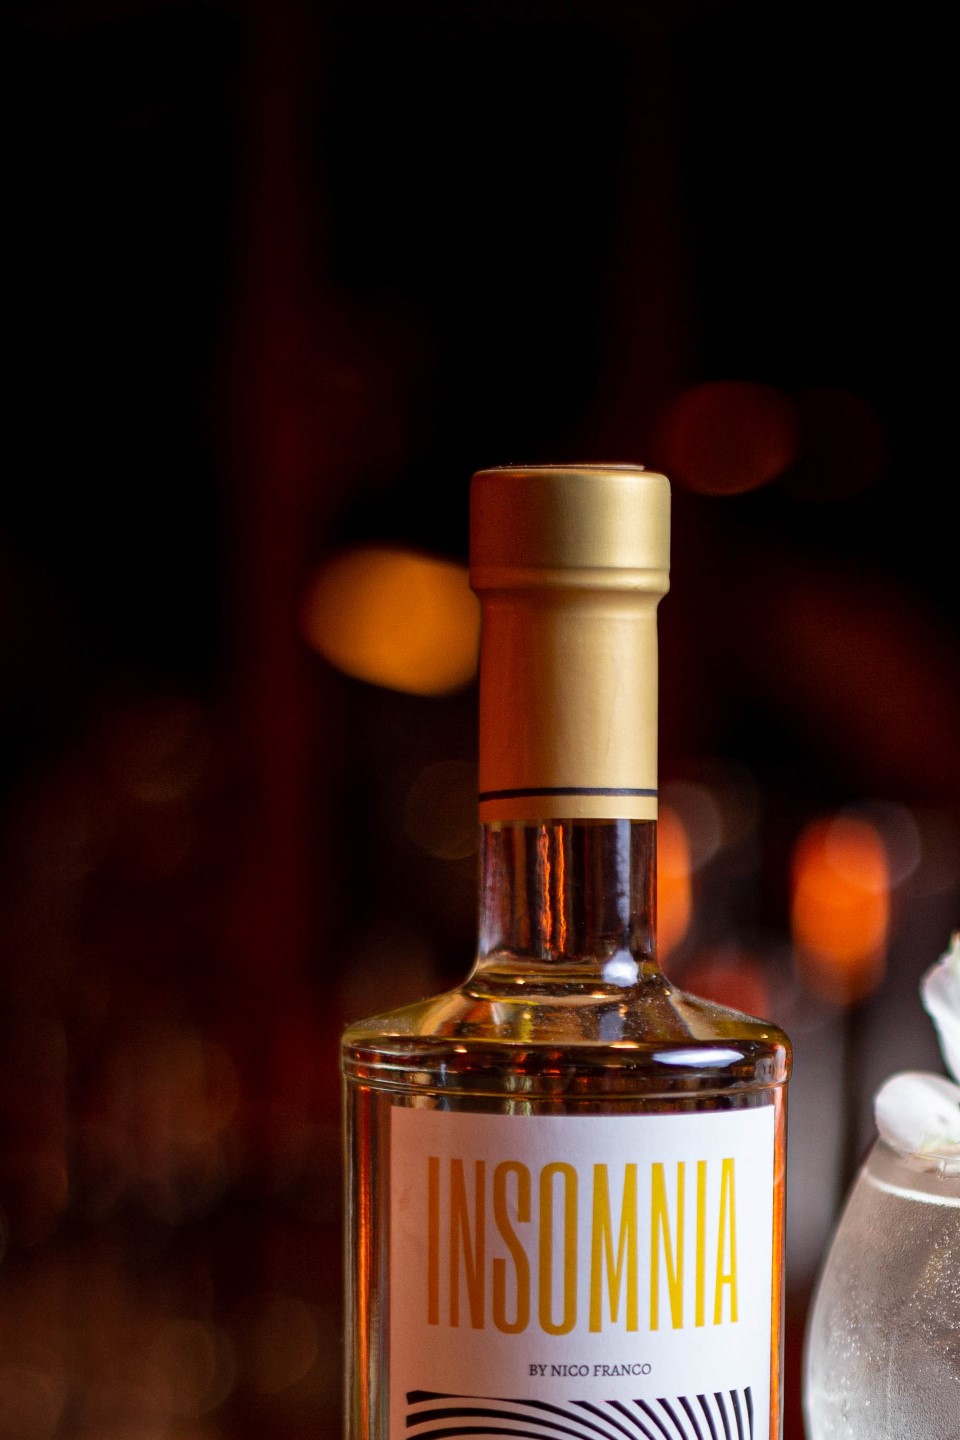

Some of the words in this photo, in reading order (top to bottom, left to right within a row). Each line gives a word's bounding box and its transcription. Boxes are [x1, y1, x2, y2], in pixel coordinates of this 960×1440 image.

[428, 1156, 738, 1336] INSOMNIA
[528, 1364, 548, 1376] BY
[551, 1364, 590, 1377] NICO
[593, 1363, 652, 1377] FRANCO
